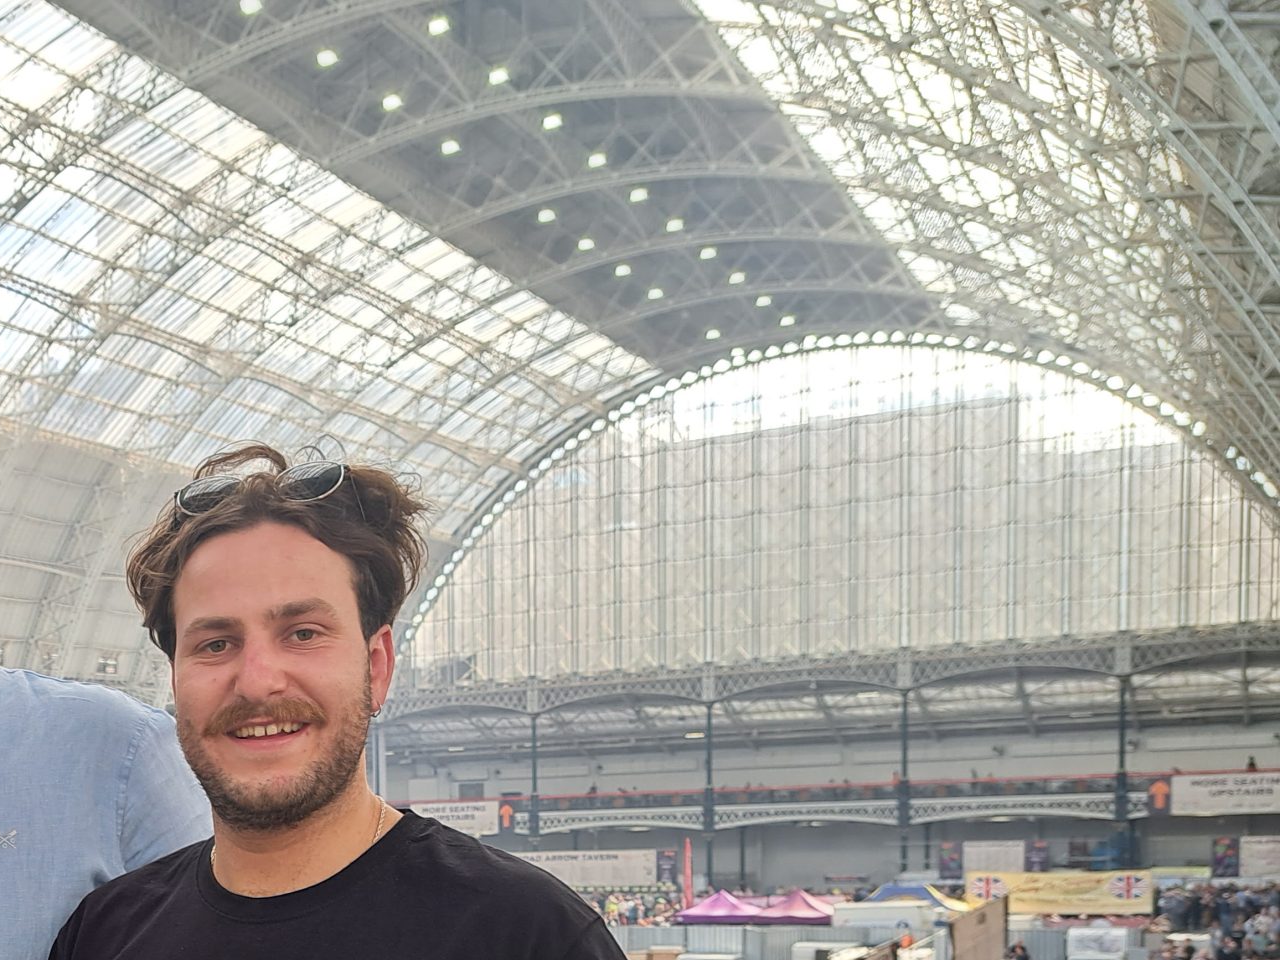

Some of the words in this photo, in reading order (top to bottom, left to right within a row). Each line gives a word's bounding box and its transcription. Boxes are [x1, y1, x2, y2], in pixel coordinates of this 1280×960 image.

[1234, 775, 1280, 785] SEATIN
[422, 806, 447, 814] MORE
[449, 805, 486, 813] SEATING
[545, 854, 578, 862] ARROW
[581, 853, 619, 861] TAVERN
